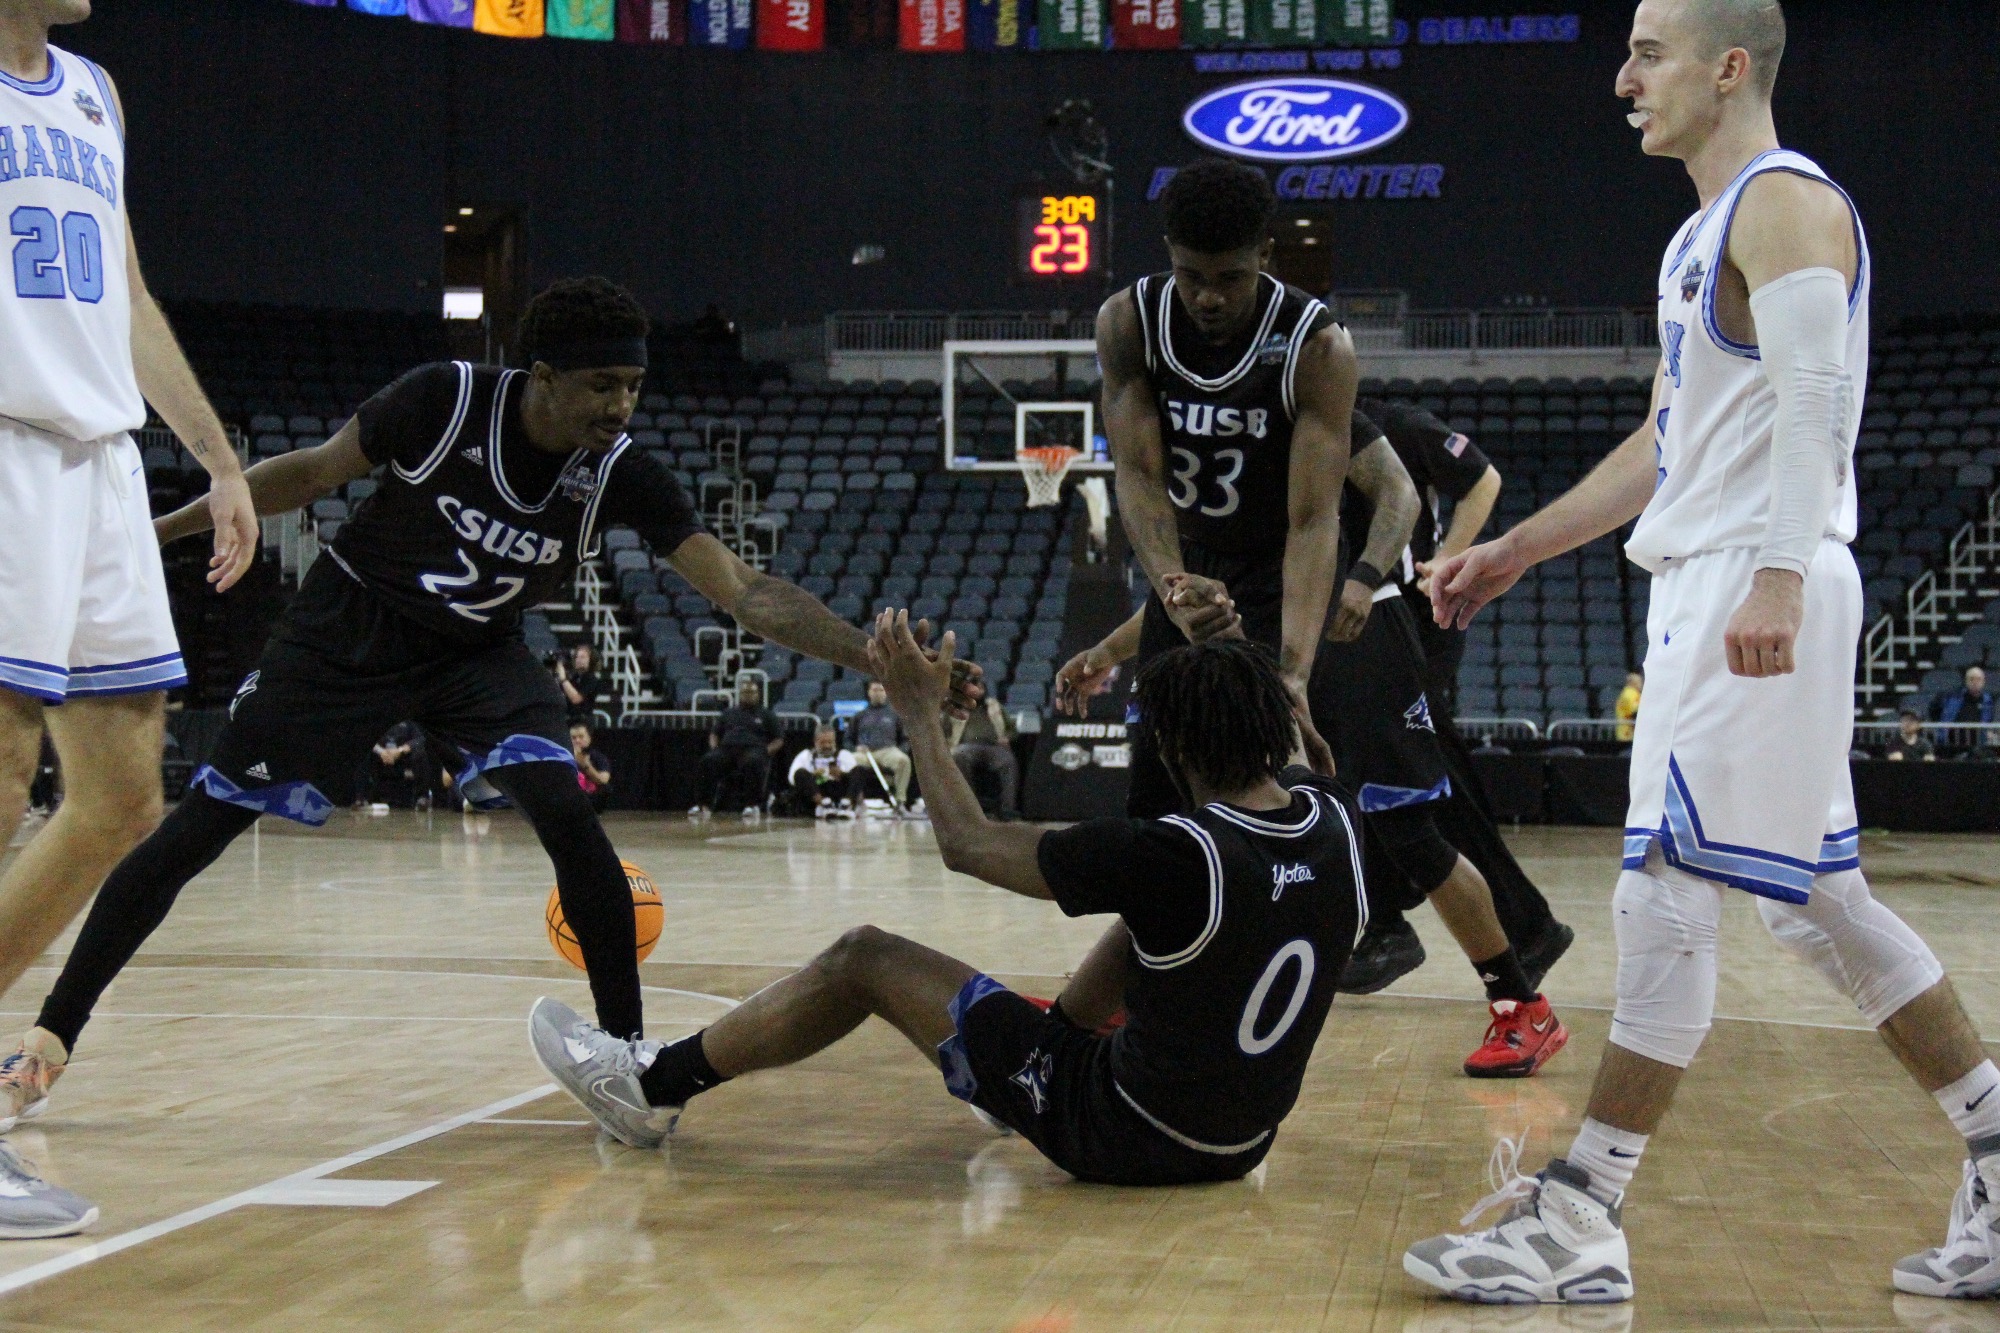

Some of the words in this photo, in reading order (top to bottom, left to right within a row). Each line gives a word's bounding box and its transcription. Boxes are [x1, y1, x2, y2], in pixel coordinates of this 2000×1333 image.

[1225, 88, 1366, 146] Ford
[1042, 195, 1096, 225] 3:09
[1276, 164, 1444, 199] CENTER
[9, 205, 104, 304] 20
[1031, 225, 1089, 274] 23
[1167, 446, 1244, 517] 33
[437, 495, 563, 565] CSUSB
[1272, 862, 1316, 902] Yotes
[1238, 939, 1315, 1055] 0
